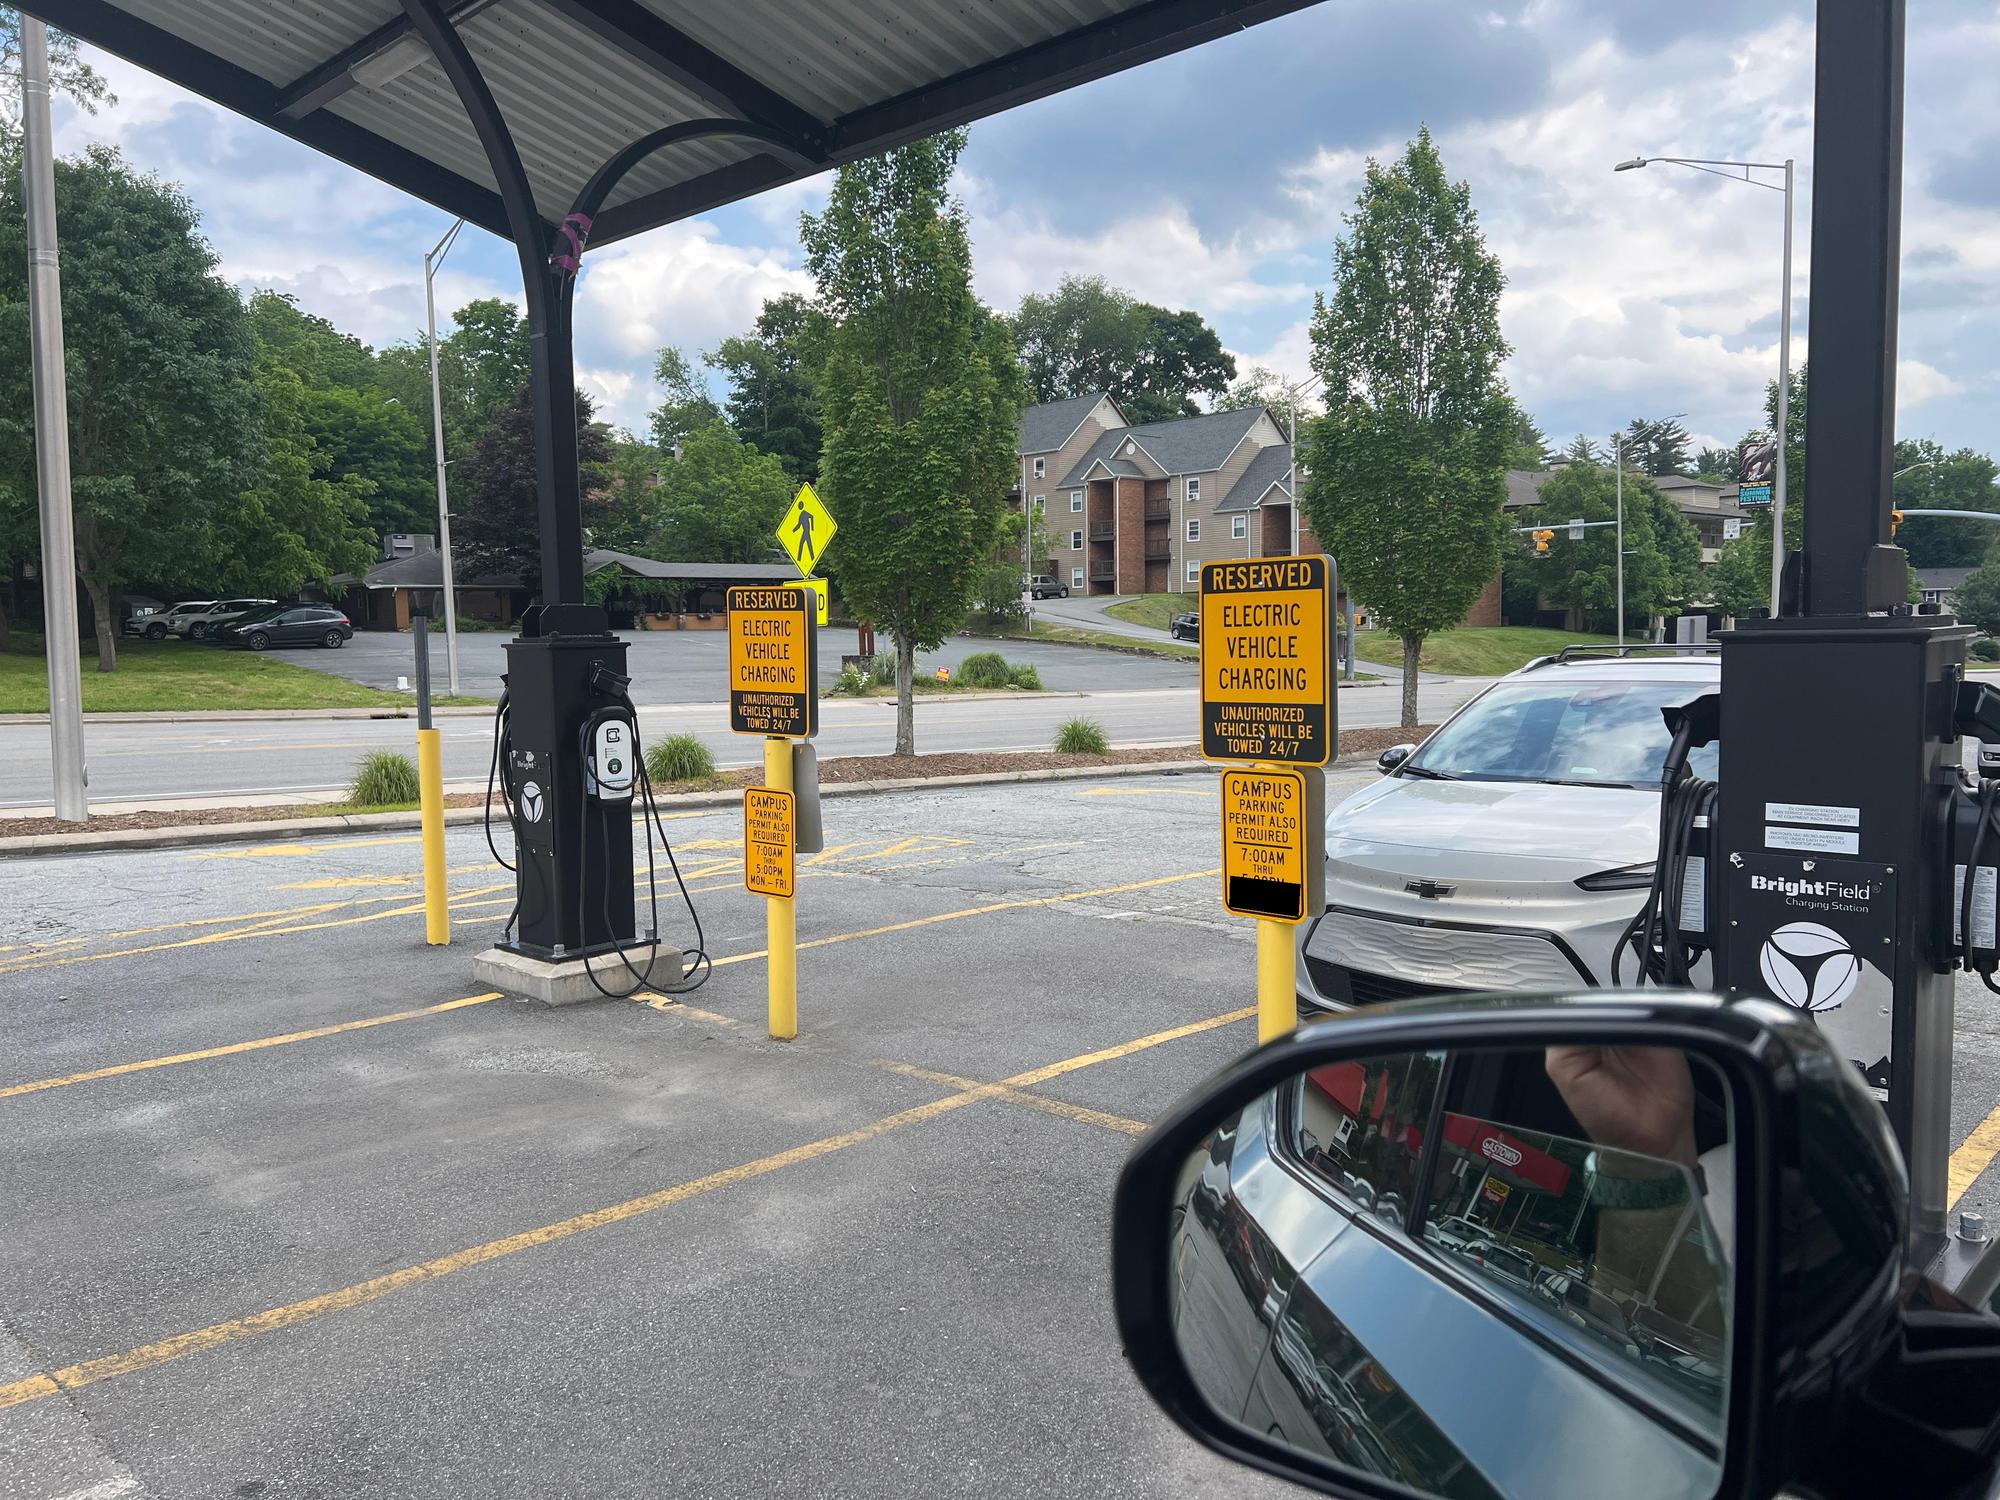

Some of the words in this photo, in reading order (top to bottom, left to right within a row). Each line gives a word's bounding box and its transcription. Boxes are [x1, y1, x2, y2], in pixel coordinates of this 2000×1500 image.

[1213, 563, 1312, 590] RESERVED
[735, 591, 797, 609] RESERVED
[1223, 603, 1301, 628] ELECTRIC
[743, 620, 791, 637] ELECTRIC
[745, 643, 790, 660] VEHICLE
[1226, 636, 1298, 659] VEHICLE
[741, 665, 796, 683] CHARGING
[1219, 667, 1307, 691] CHARGING
[742, 693, 795, 706] UNAUTHORIZED
[738, 705, 771, 717] VEHICLES
[771, 706, 789, 718] WILL
[790, 707, 800, 719] BE
[1221, 706, 1305, 722] UNAUTHORIZED
[747, 717, 769, 729] TOWED
[772, 718, 792, 732] 24/7
[1214, 722, 1265, 738] VEHICLES
[1268, 724, 1295, 739] WILL
[1298, 725, 1313, 740] BE
[1227, 738, 1263, 754] TOWED
[1269, 740, 1300, 758] 24/7
[1232, 779, 1292, 800] CAMPUS
[750, 795, 788, 811] CAMPUS
[1239, 798, 1285, 814] PARKING
[755, 809, 783, 821] PARKING
[1229, 812, 1266, 826] PERMIT
[1269, 816, 1296, 829] ALSO
[749, 819, 771, 830] PERMIT
[773, 822, 790, 833] ALSO
[753, 830, 786, 842] REQUIRED
[1236, 827, 1289, 843] REQUIRED
[756, 845, 783, 858] 7:00AM
[1241, 847, 1285, 865] 7:00AM
[1253, 863, 1273, 875] THRU
[1785, 897, 1829, 911] Charging
[1831, 901, 1869, 913] Station
